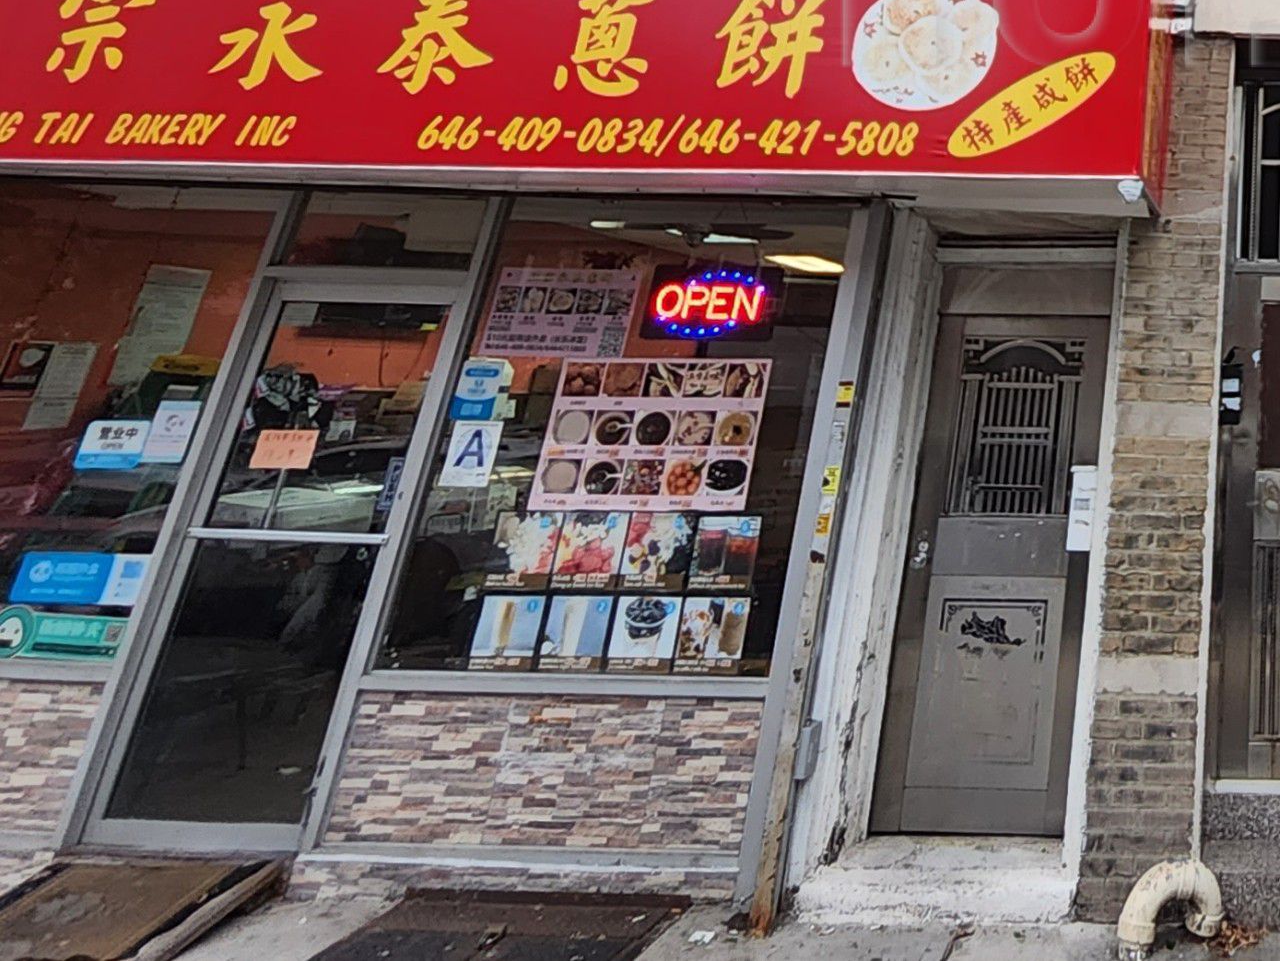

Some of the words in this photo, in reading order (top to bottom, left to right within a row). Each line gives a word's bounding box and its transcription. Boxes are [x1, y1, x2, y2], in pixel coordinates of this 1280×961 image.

[34, 112, 94, 144] TAI
[105, 113, 226, 146] BAKERY
[235, 115, 297, 147] INC
[417, 114, 919, 157] 646-409-0834/646-421-5808
[656, 285, 764, 321] OPEN
[453, 429, 484, 467] A
